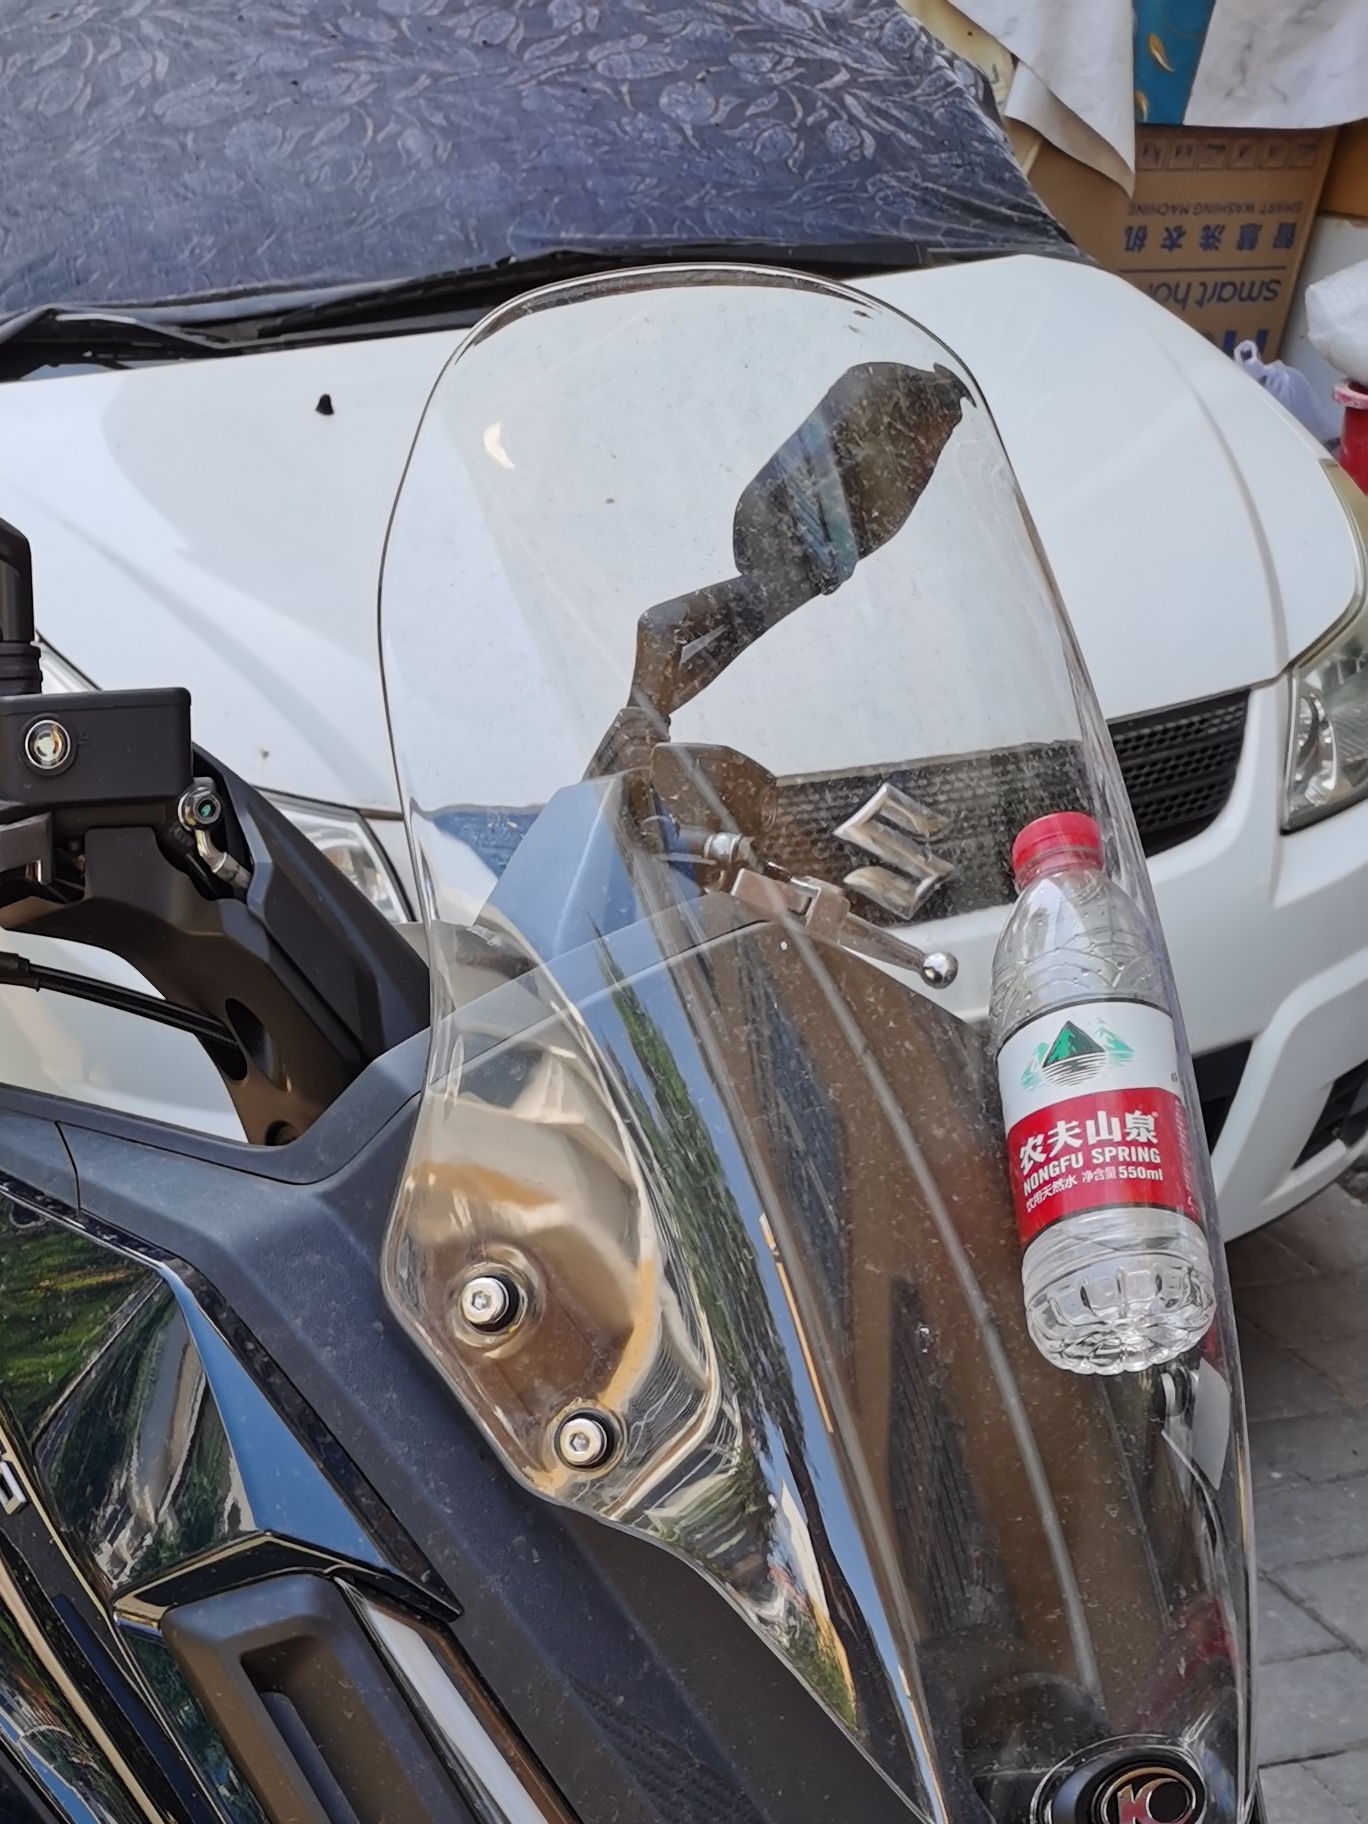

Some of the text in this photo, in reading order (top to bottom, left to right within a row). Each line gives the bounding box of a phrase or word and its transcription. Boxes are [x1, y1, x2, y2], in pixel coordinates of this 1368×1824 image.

[1192, 201, 1256, 217] WASHING
[1195, 279, 1282, 310] smart
[1020, 1109, 1159, 1175] 农夫山泉
[1023, 1146, 1161, 1197] NONGFU SPRING
